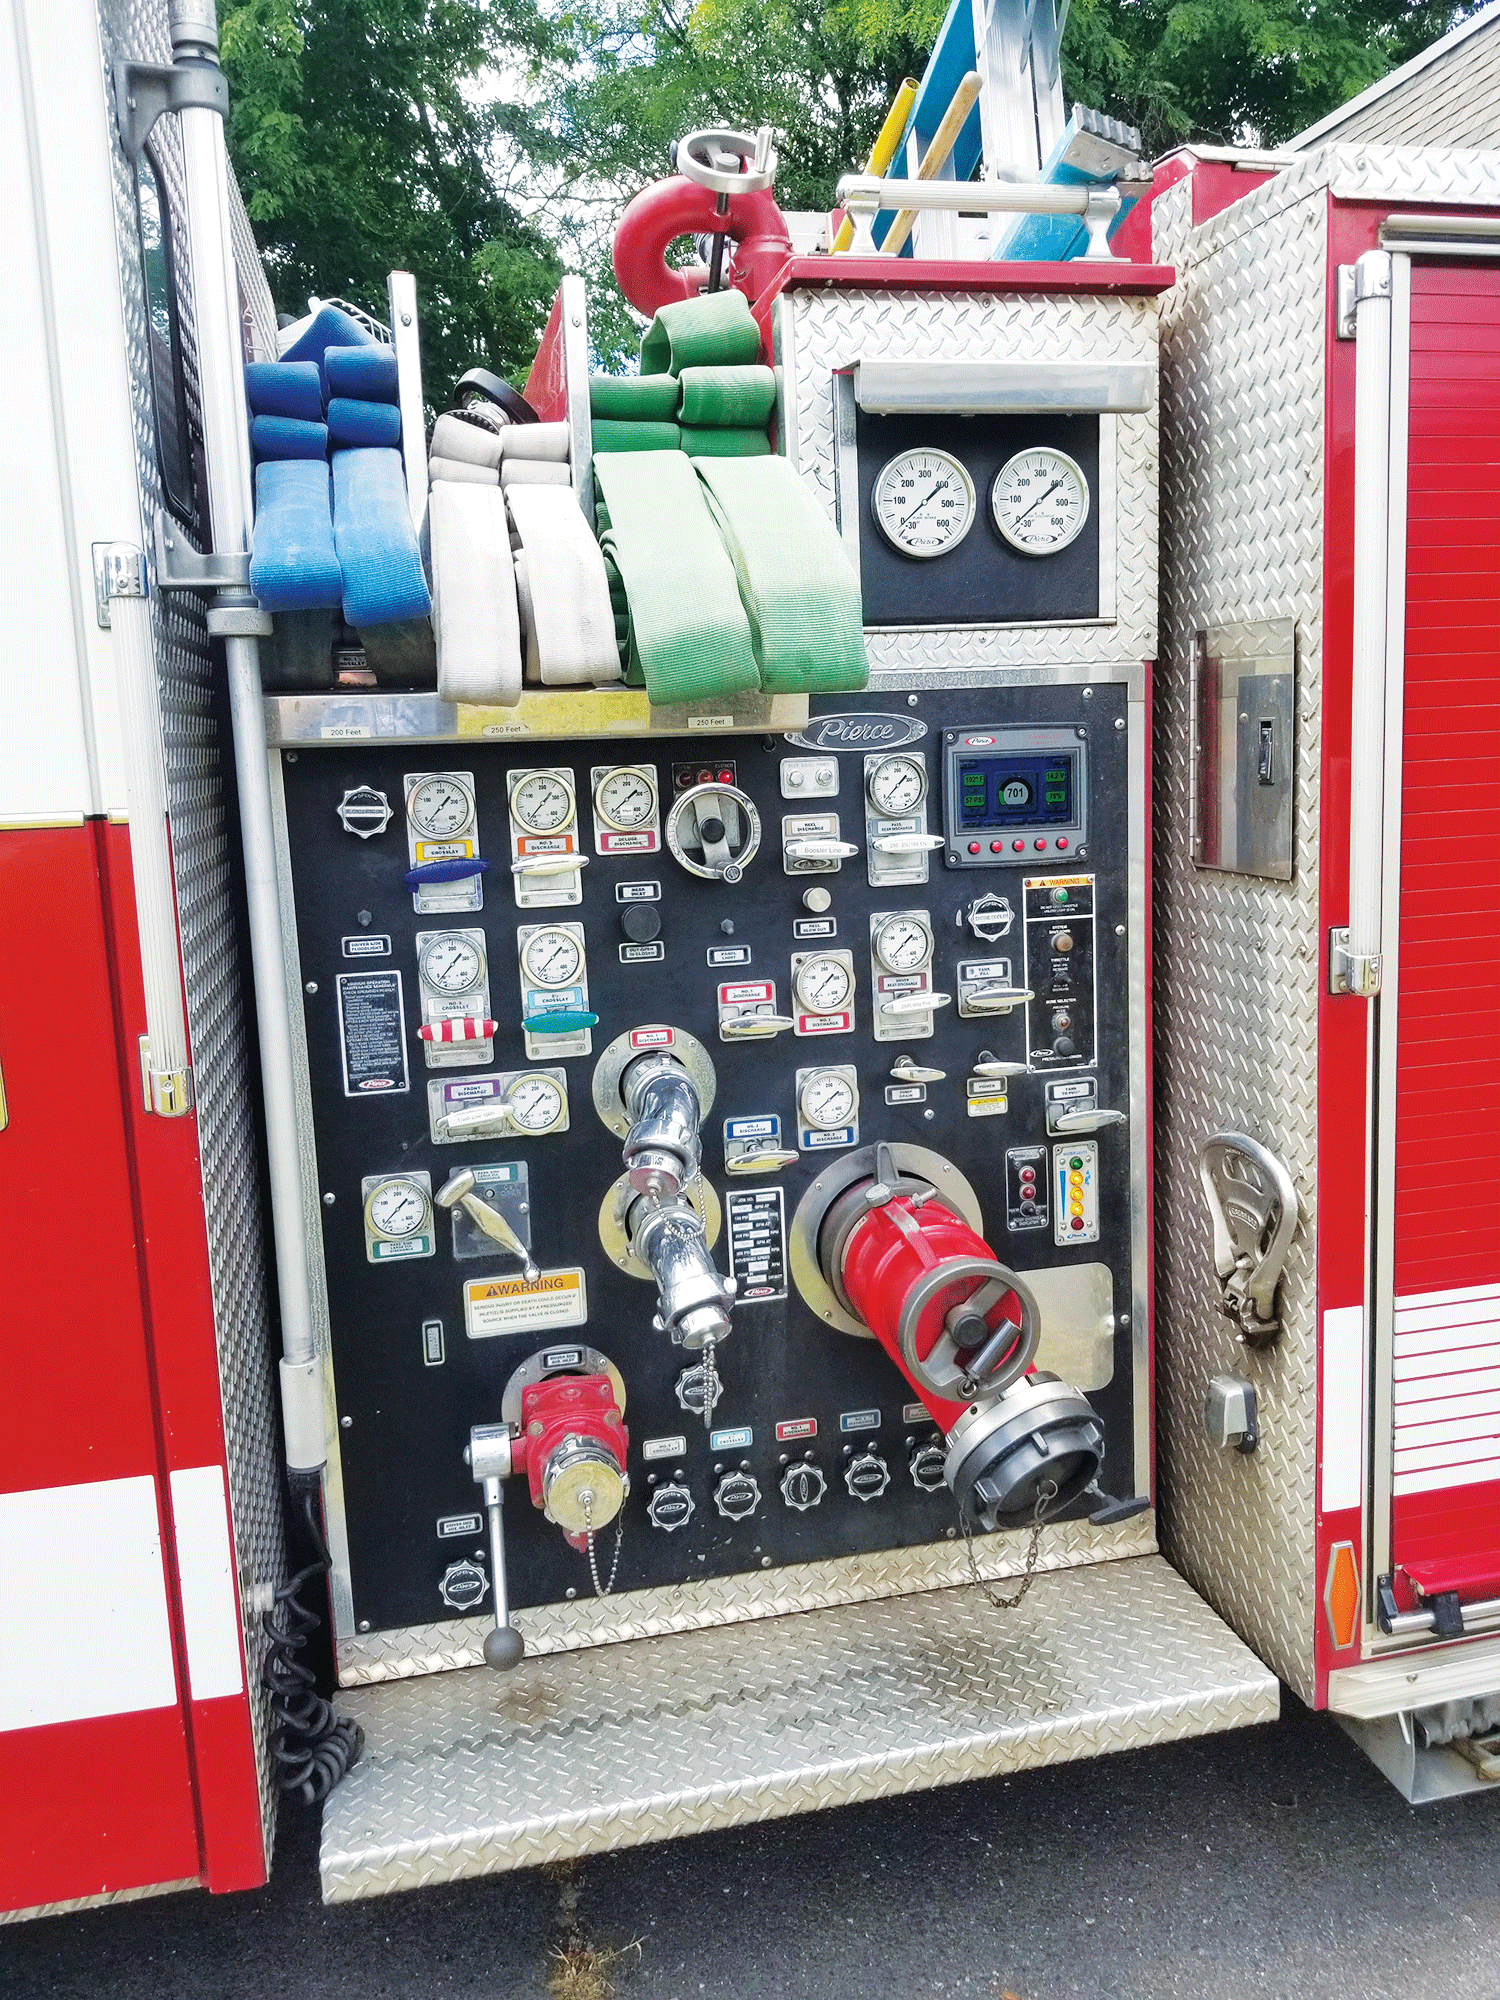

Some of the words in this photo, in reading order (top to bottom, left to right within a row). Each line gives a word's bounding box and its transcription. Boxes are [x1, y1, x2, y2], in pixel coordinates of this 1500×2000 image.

[816, 719, 895, 745] Pierce
[1007, 788, 1023, 798] 701
[498, 1278, 564, 1295] WARNING
